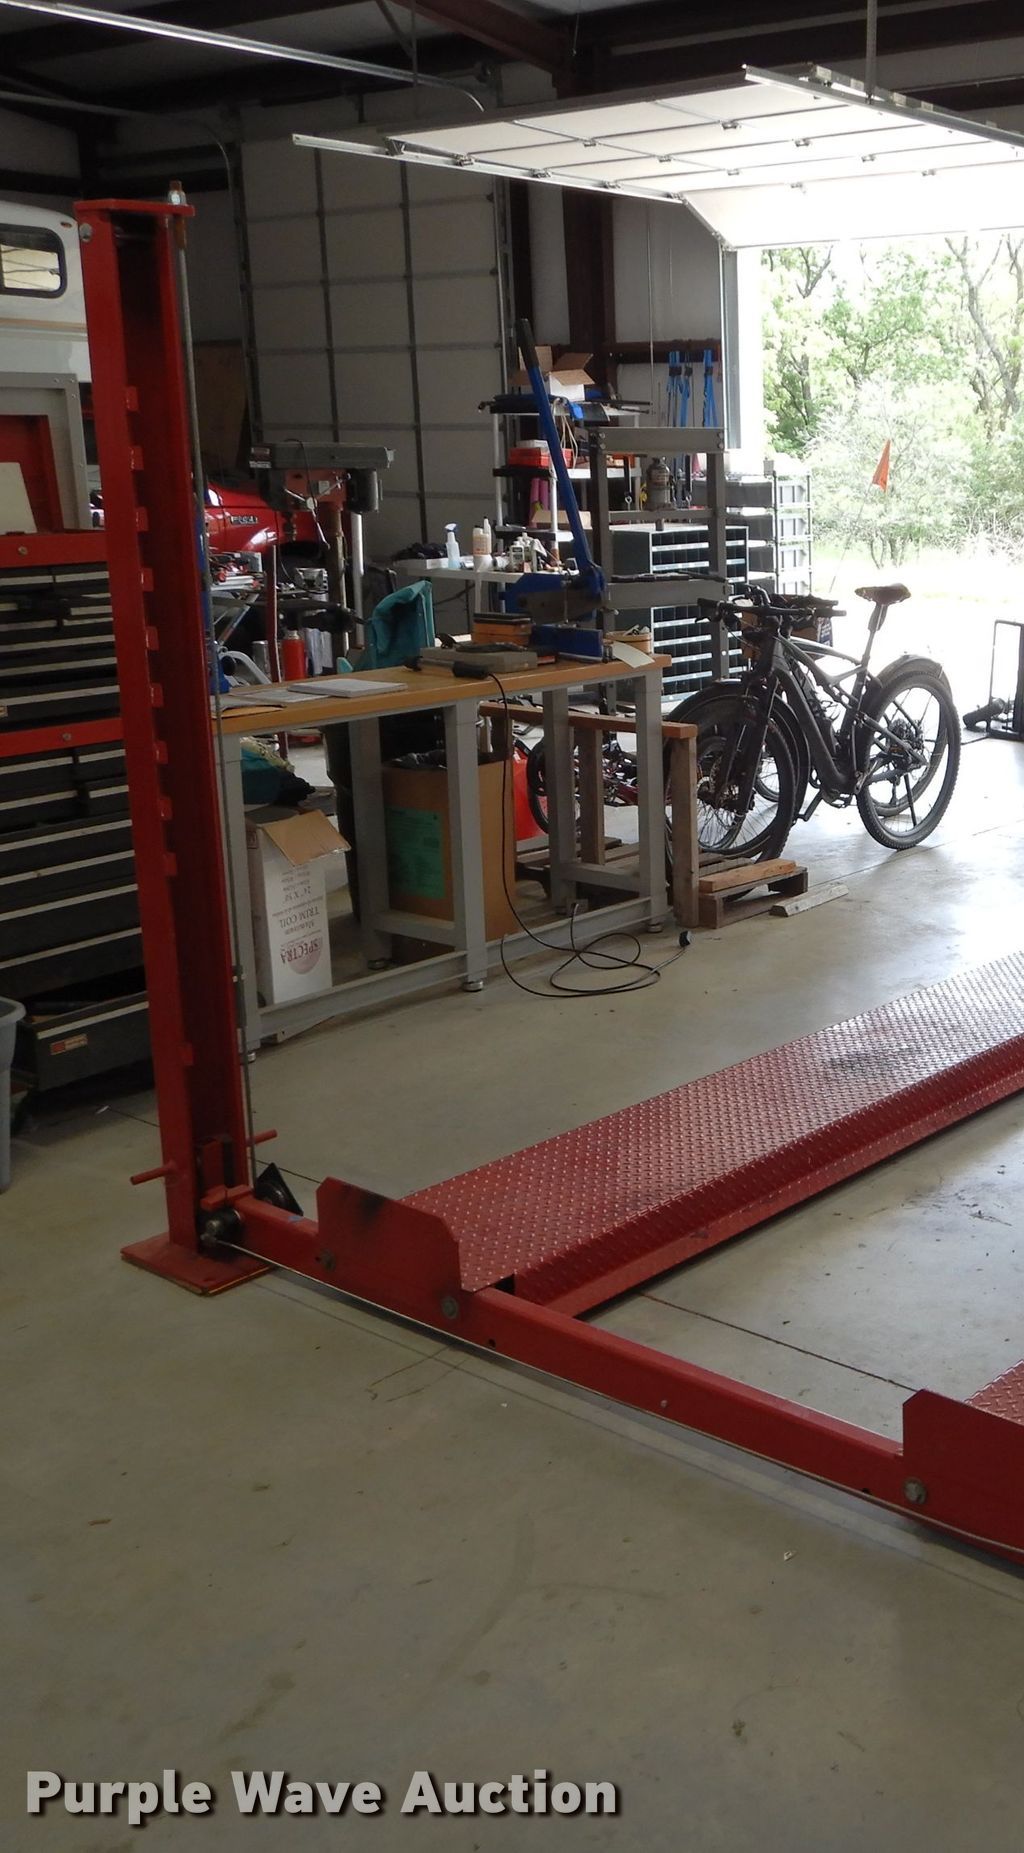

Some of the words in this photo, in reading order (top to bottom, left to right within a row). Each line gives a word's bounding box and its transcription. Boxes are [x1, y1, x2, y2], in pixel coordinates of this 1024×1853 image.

[280, 913, 298, 929] COIL
[299, 905, 320, 921] TRIM
[280, 937, 319, 964] SPECTRA
